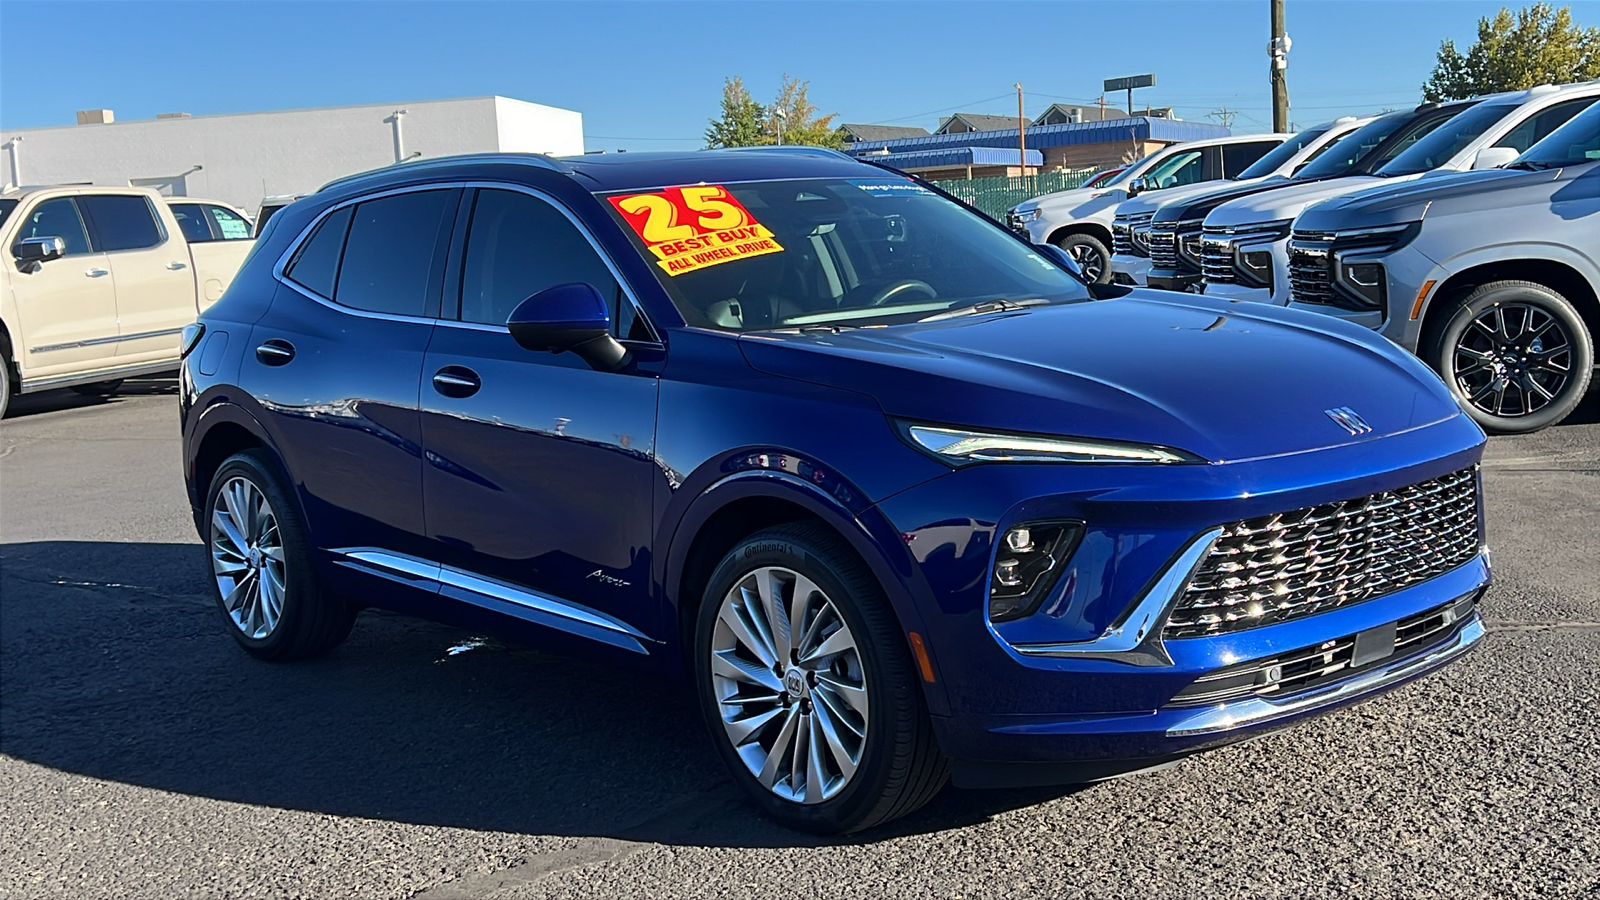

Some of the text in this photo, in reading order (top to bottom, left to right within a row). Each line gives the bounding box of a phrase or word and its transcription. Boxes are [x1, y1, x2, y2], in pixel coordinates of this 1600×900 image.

[618, 187, 748, 243] 25
[659, 227, 759, 257] BEST BUY
[667, 240, 776, 272] ALL WHEEL DRIVE
[744, 542, 787, 559] Continental
